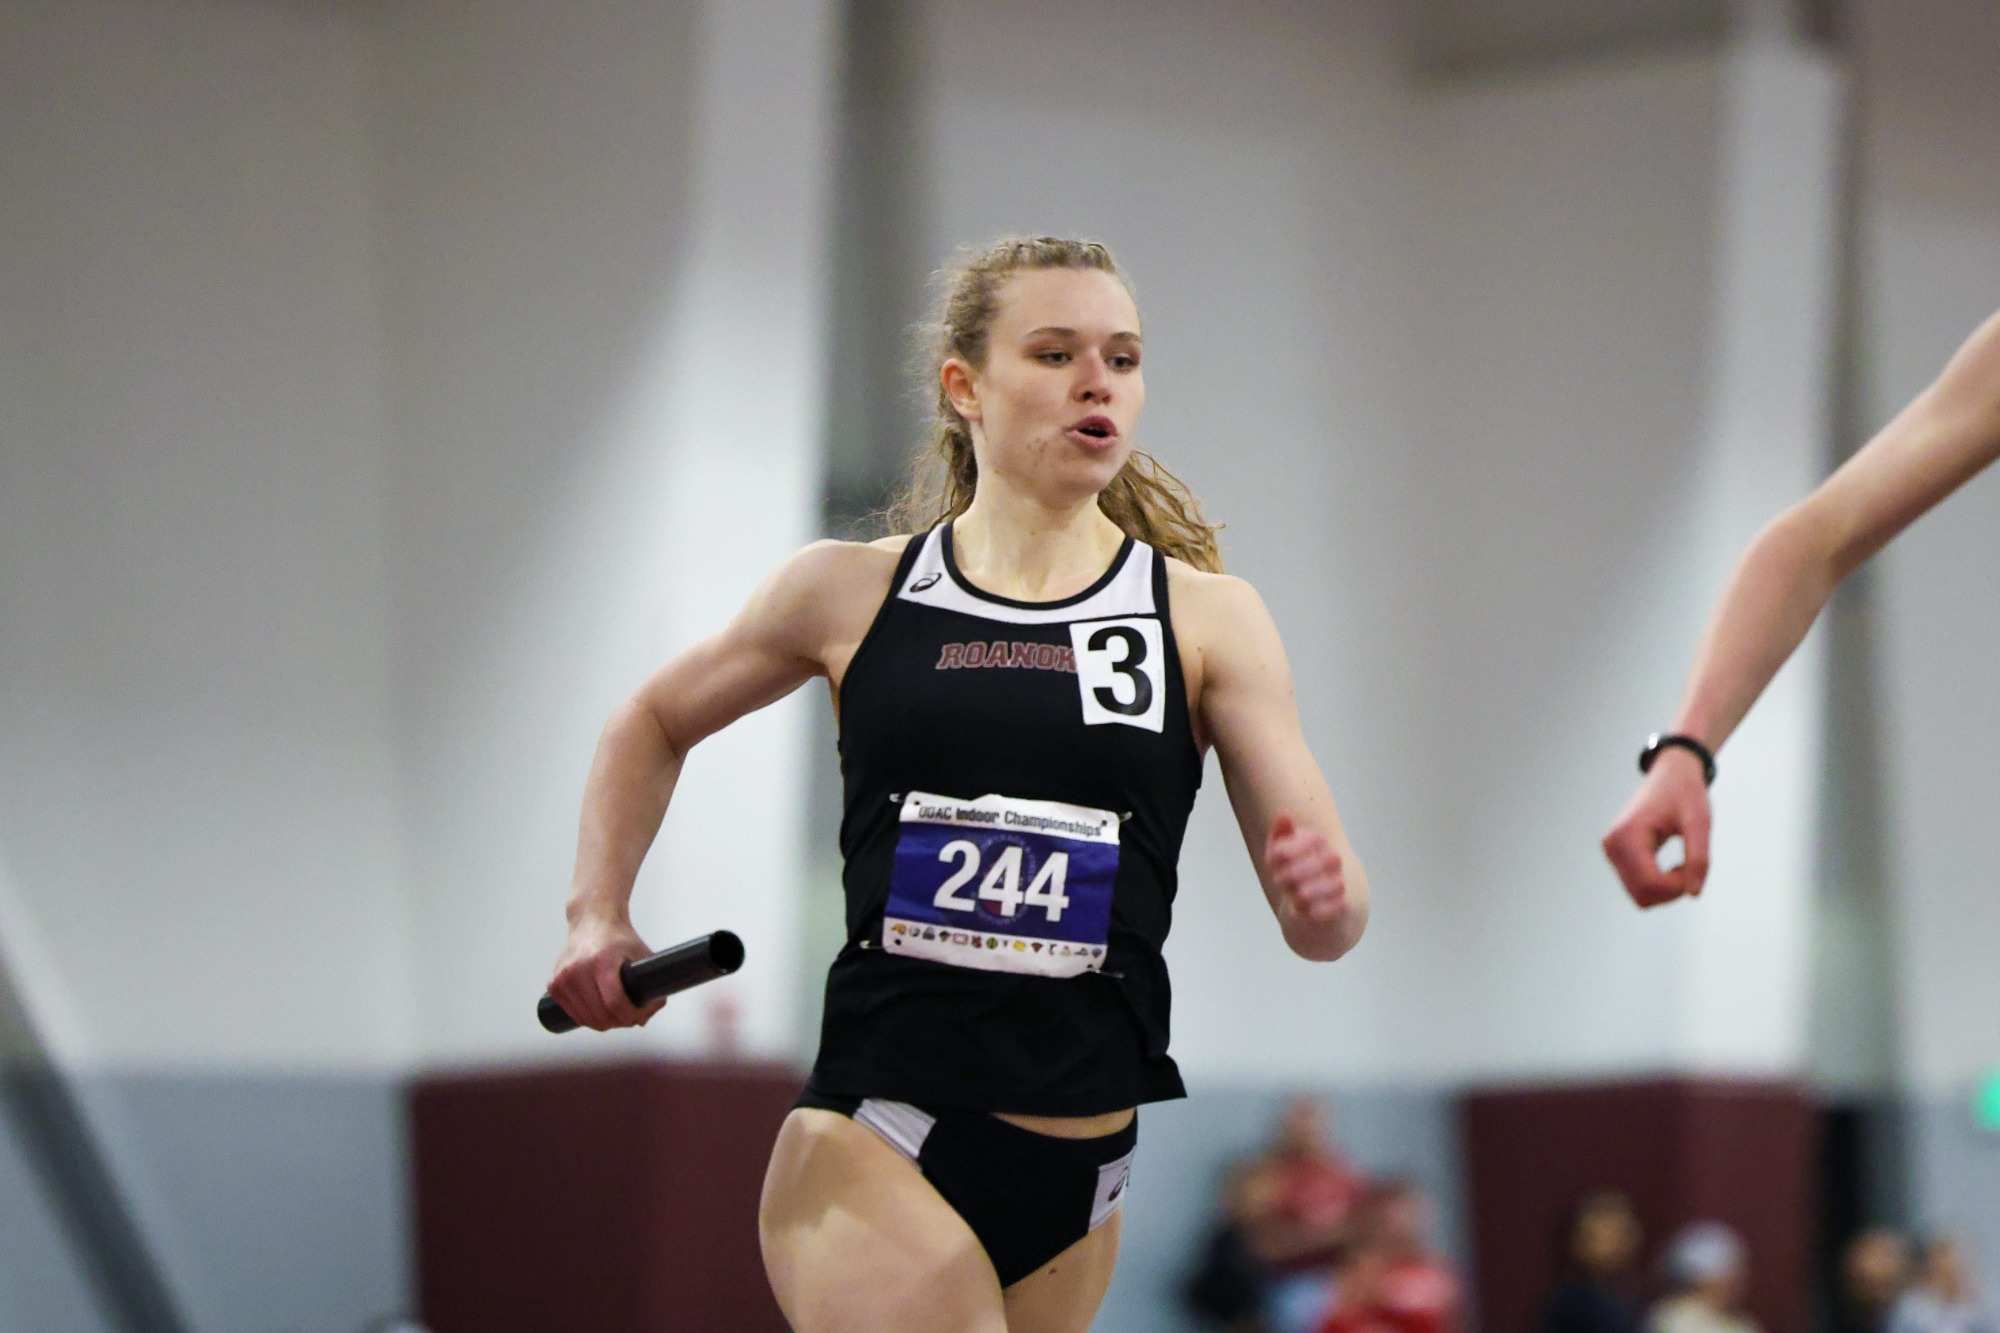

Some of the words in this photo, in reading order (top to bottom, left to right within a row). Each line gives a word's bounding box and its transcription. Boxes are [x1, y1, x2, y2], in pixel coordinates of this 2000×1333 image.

[935, 640, 1078, 674] ROANOK
[1088, 626, 1152, 716] 3
[956, 807, 1000, 823] Indoor
[1004, 810, 1102, 837] Championships
[933, 839, 1070, 922] 244
